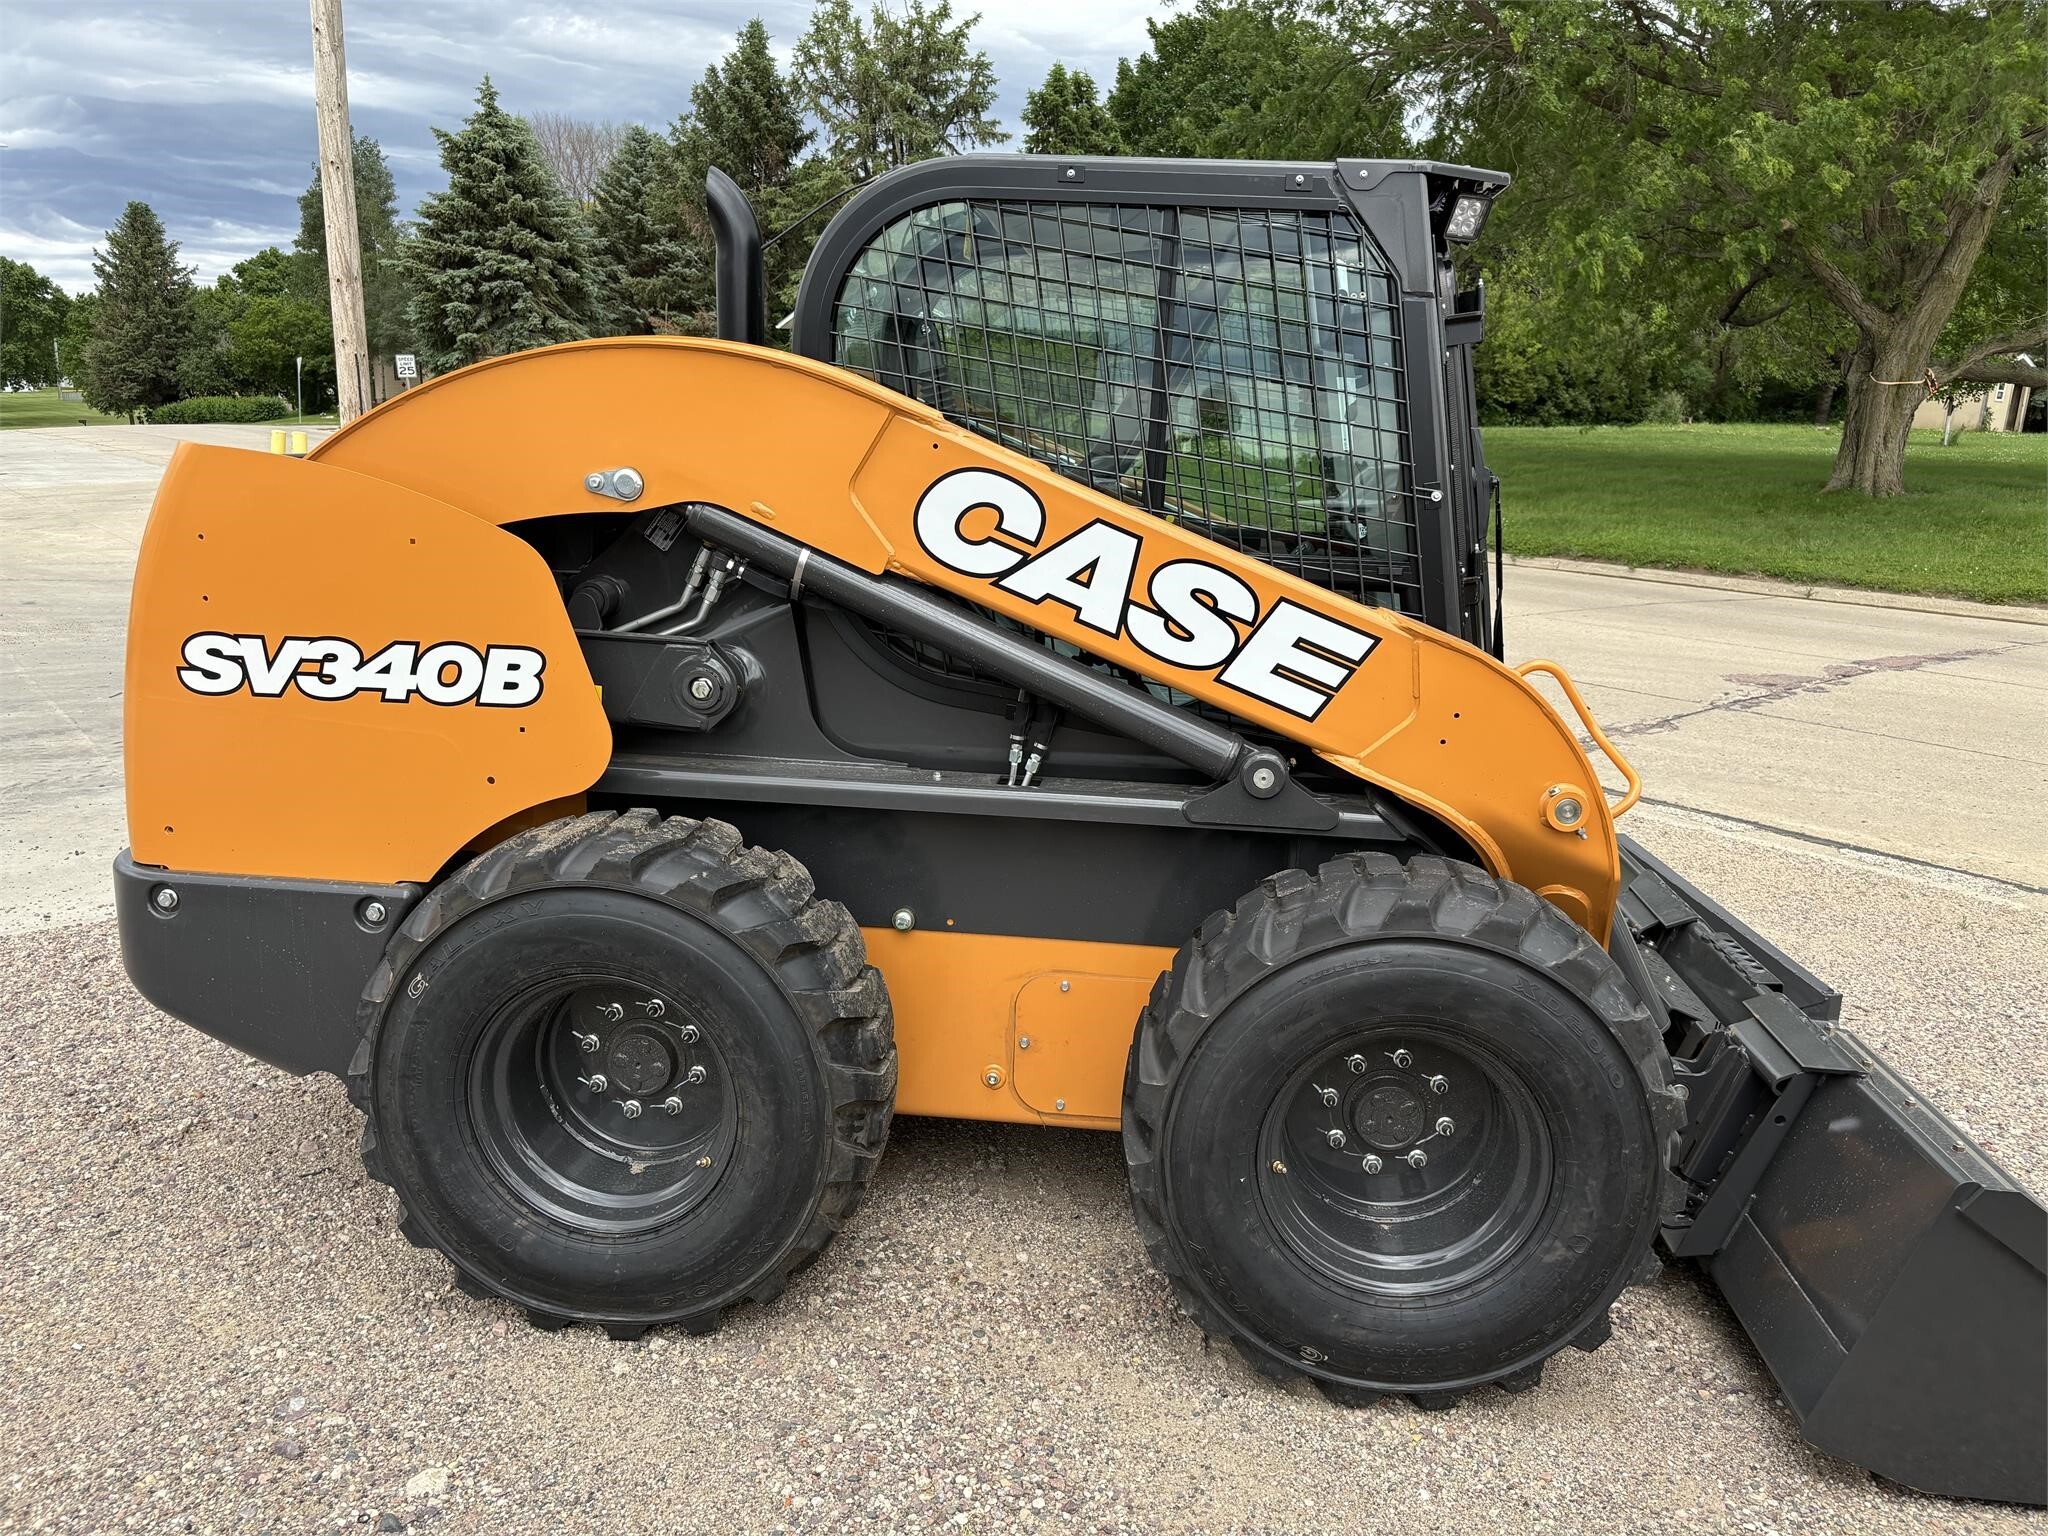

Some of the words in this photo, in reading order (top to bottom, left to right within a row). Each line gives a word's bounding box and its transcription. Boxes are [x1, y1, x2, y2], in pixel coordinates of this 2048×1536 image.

[399, 366, 415, 375] 25
[913, 466, 1381, 723] CASE
[176, 631, 546, 708] SV340B
[1511, 970, 1625, 1090] XD2010
